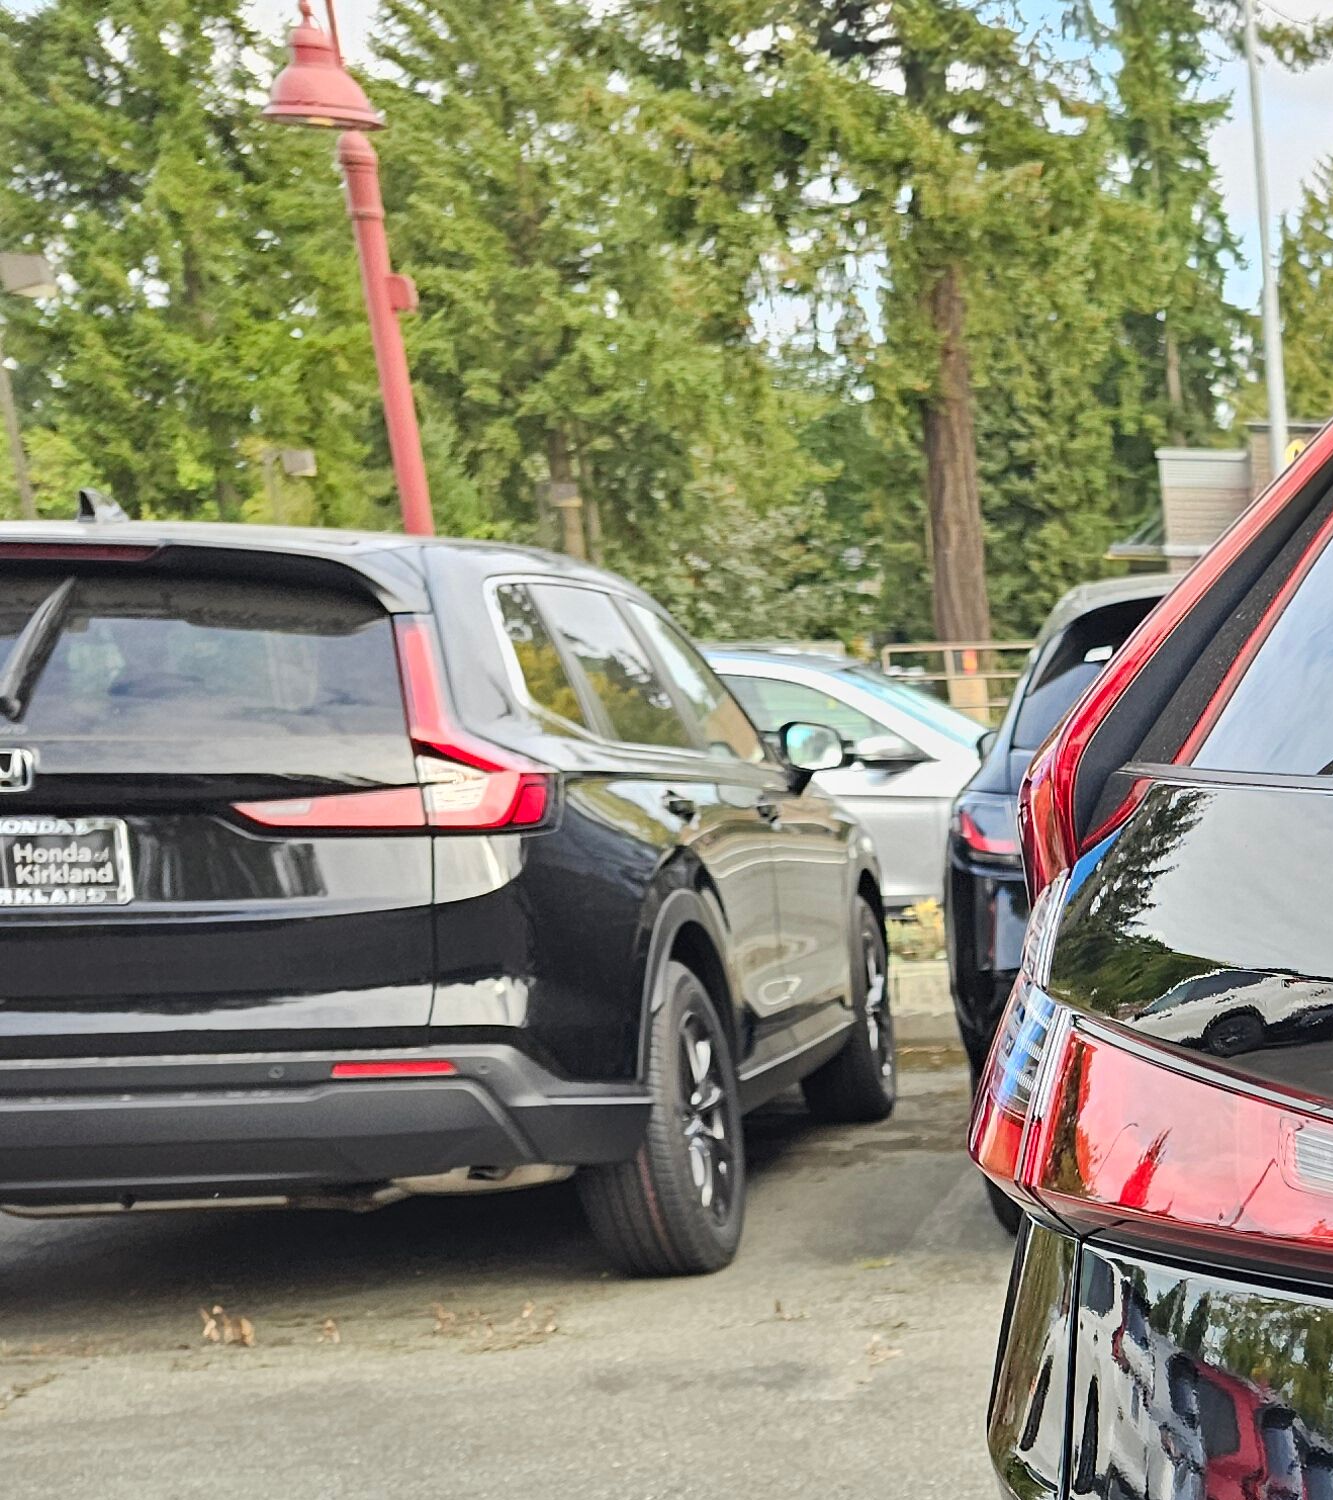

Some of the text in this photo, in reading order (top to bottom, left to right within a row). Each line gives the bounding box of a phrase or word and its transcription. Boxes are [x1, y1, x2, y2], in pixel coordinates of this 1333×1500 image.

[0, 820, 74, 833] ONDA
[13, 842, 92, 863] Honda
[15, 861, 113, 884] Kirkland
